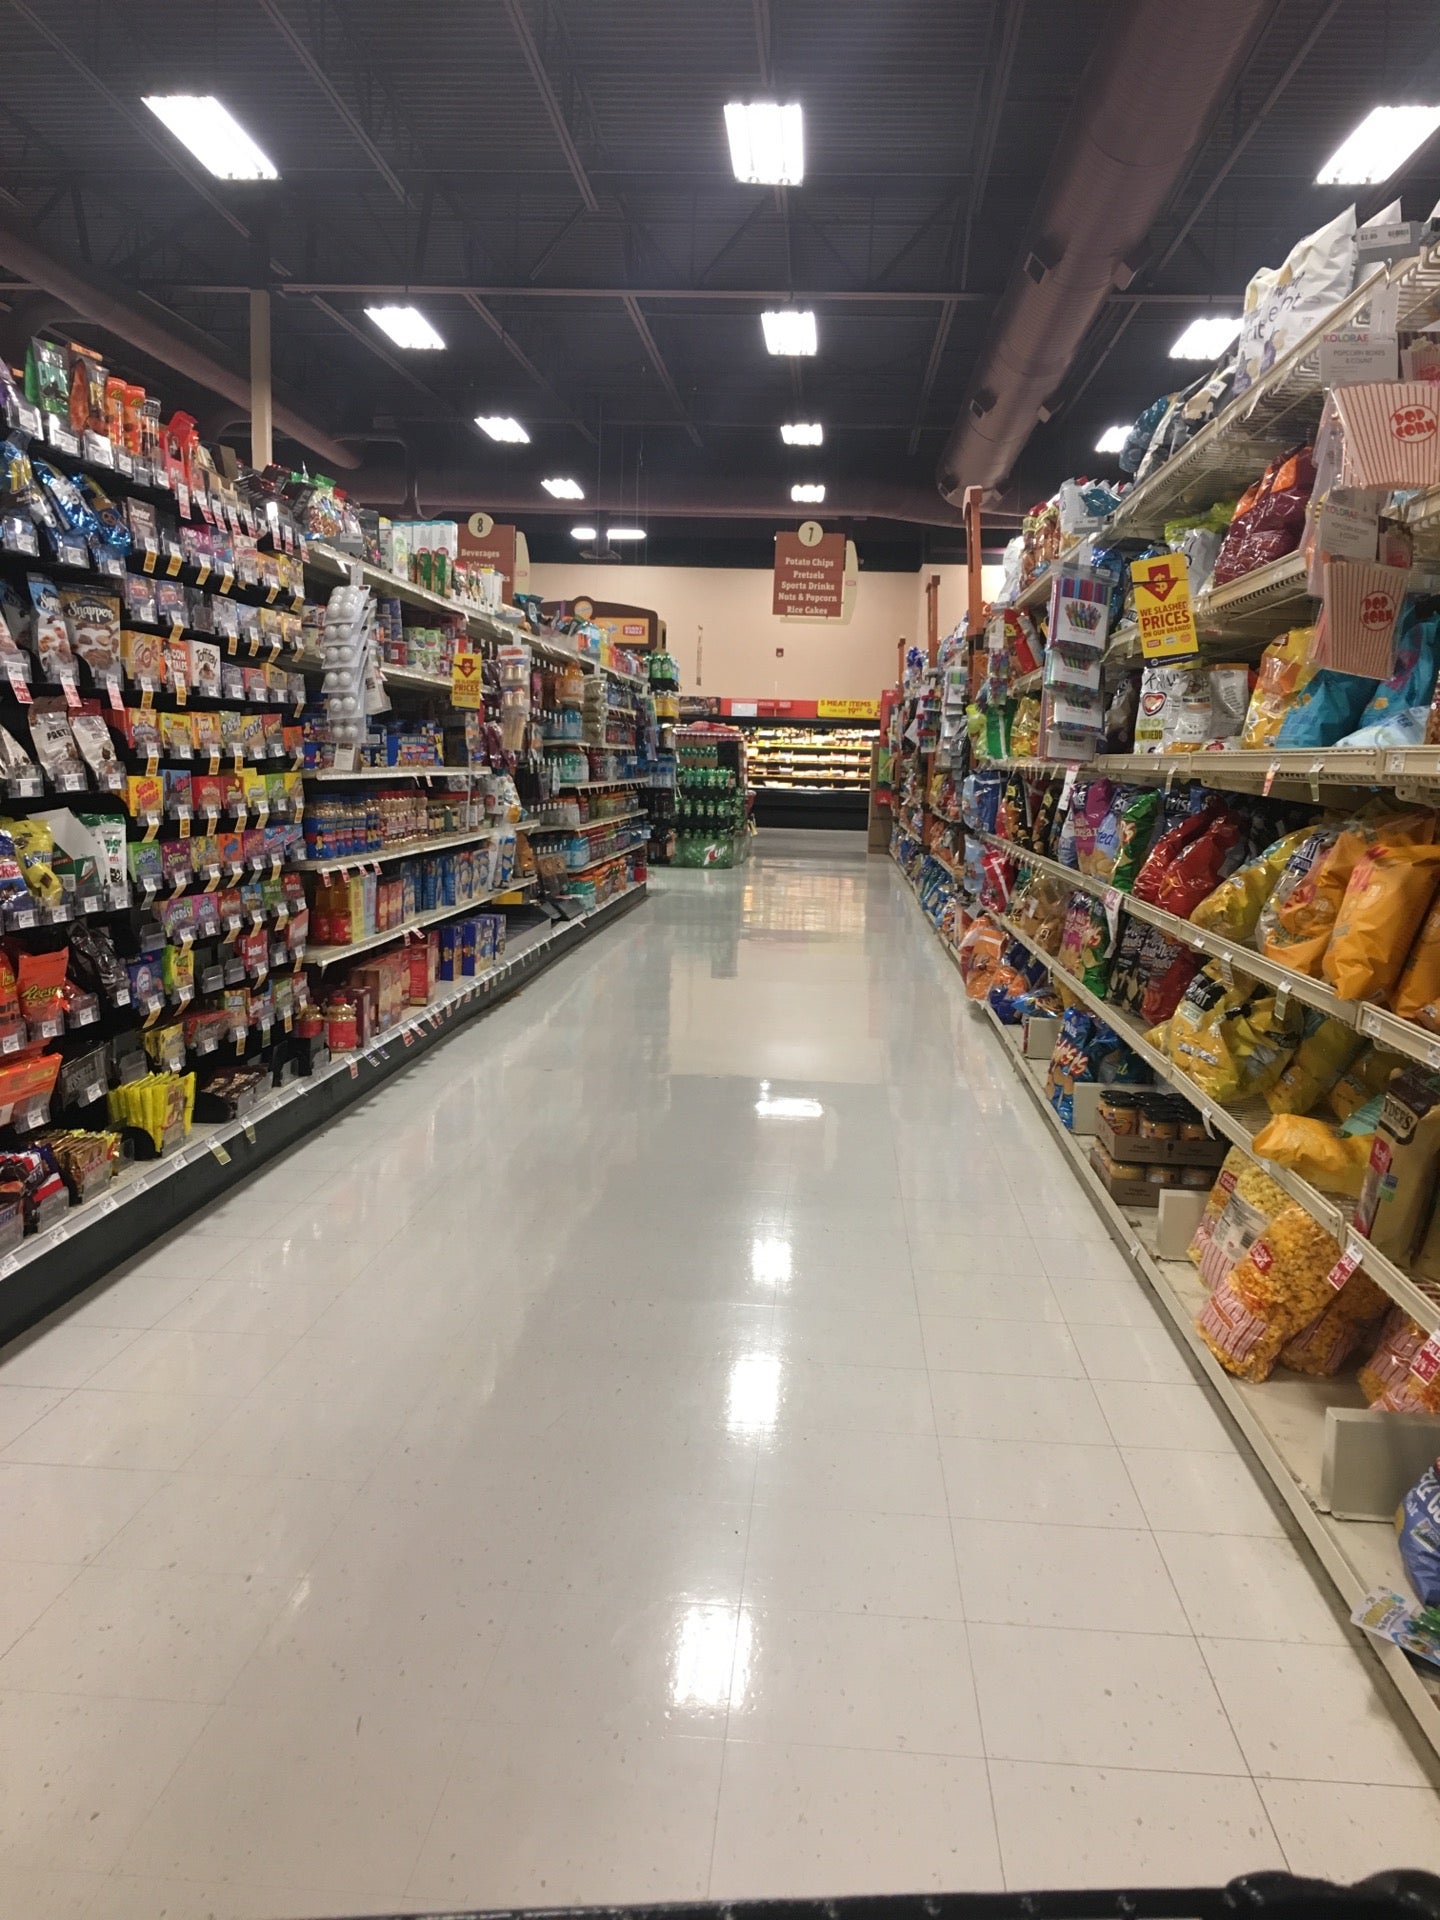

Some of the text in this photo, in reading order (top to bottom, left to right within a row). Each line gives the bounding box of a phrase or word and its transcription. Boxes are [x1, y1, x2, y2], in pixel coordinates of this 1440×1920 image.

[1323, 334, 1369, 342] KOLORAE
[1395, 409, 1425, 426] POP
[1396, 422, 1437, 438] CORN
[478, 517, 484, 533] 8
[808, 527, 814, 542] 7
[462, 548, 500, 558] Beverages
[786, 557, 834, 568] Potato Chips
[793, 570, 824, 579] Pretzels
[782, 582, 806, 590] Sports
[806, 594, 837, 603] Popcorn
[1366, 596, 1388, 611] POP
[1140, 601, 1188, 617] WE SLASHED
[1142, 610, 1190, 631] PRICES
[1363, 610, 1394, 624] CORN
[172, 649, 186, 659] COW
[454, 684, 479, 693] PRICES
